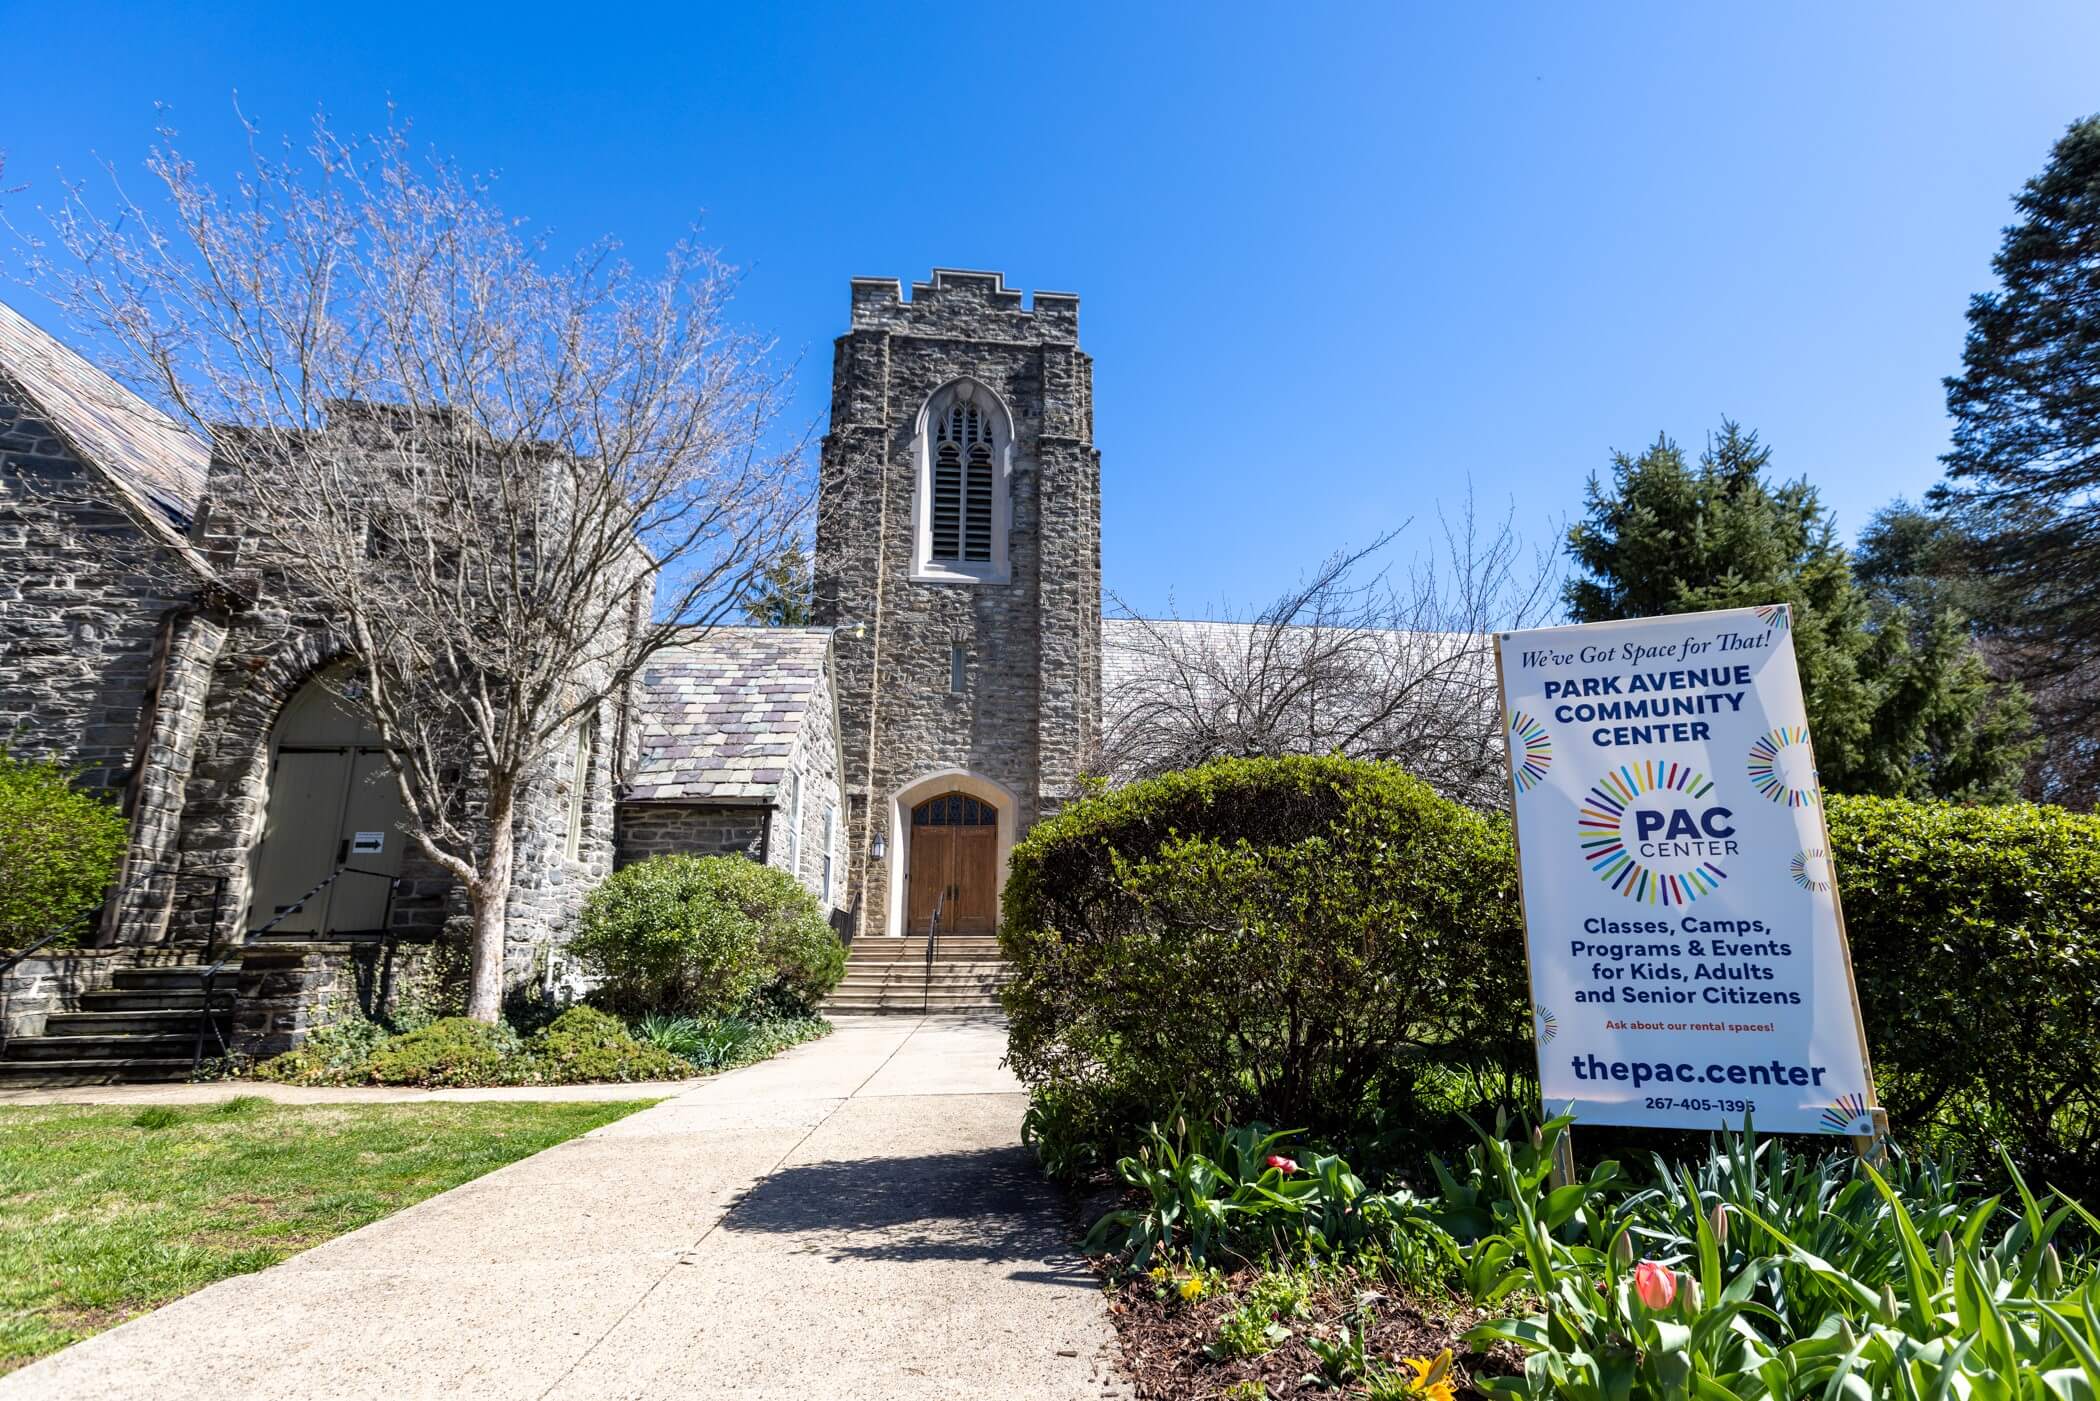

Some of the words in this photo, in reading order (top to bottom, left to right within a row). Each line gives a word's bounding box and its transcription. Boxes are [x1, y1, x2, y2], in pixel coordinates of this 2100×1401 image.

[1521, 650, 1574, 669] We've
[1580, 646, 1615, 664] Got
[1621, 642, 1677, 665] Space
[1677, 637, 1711, 662] for
[1715, 630, 1771, 652] That!
[1544, 675, 1622, 700] PARK
[1629, 665, 1752, 692] AVENUE
[1554, 691, 1745, 724] COMMUNITY
[1592, 722, 1711, 747] CENTER
[1636, 806, 1736, 841] PAC
[1639, 840, 1740, 858] CENTER
[1583, 917, 1676, 936] Classes,
[1680, 917, 1771, 936] Camps,
[1571, 940, 1681, 960] Programs
[1687, 940, 1706, 956] &
[1712, 940, 1792, 957] Events
[1592, 963, 1624, 980] for
[1631, 963, 1689, 983] Kids,
[1694, 963, 1773, 980] Adults
[1574, 987, 1615, 1004] and
[1622, 987, 1697, 1003] Senior
[1702, 987, 1801, 1005] Citizens
[1606, 1020, 1626, 1030] Ask
[1630, 1020, 1664, 1030] about
[1667, 1022, 1687, 1030] our
[1690, 1022, 1725, 1032] rental
[1728, 1021, 1775, 1034] spaces!
[1571, 1053, 1826, 1088] thepac.center
